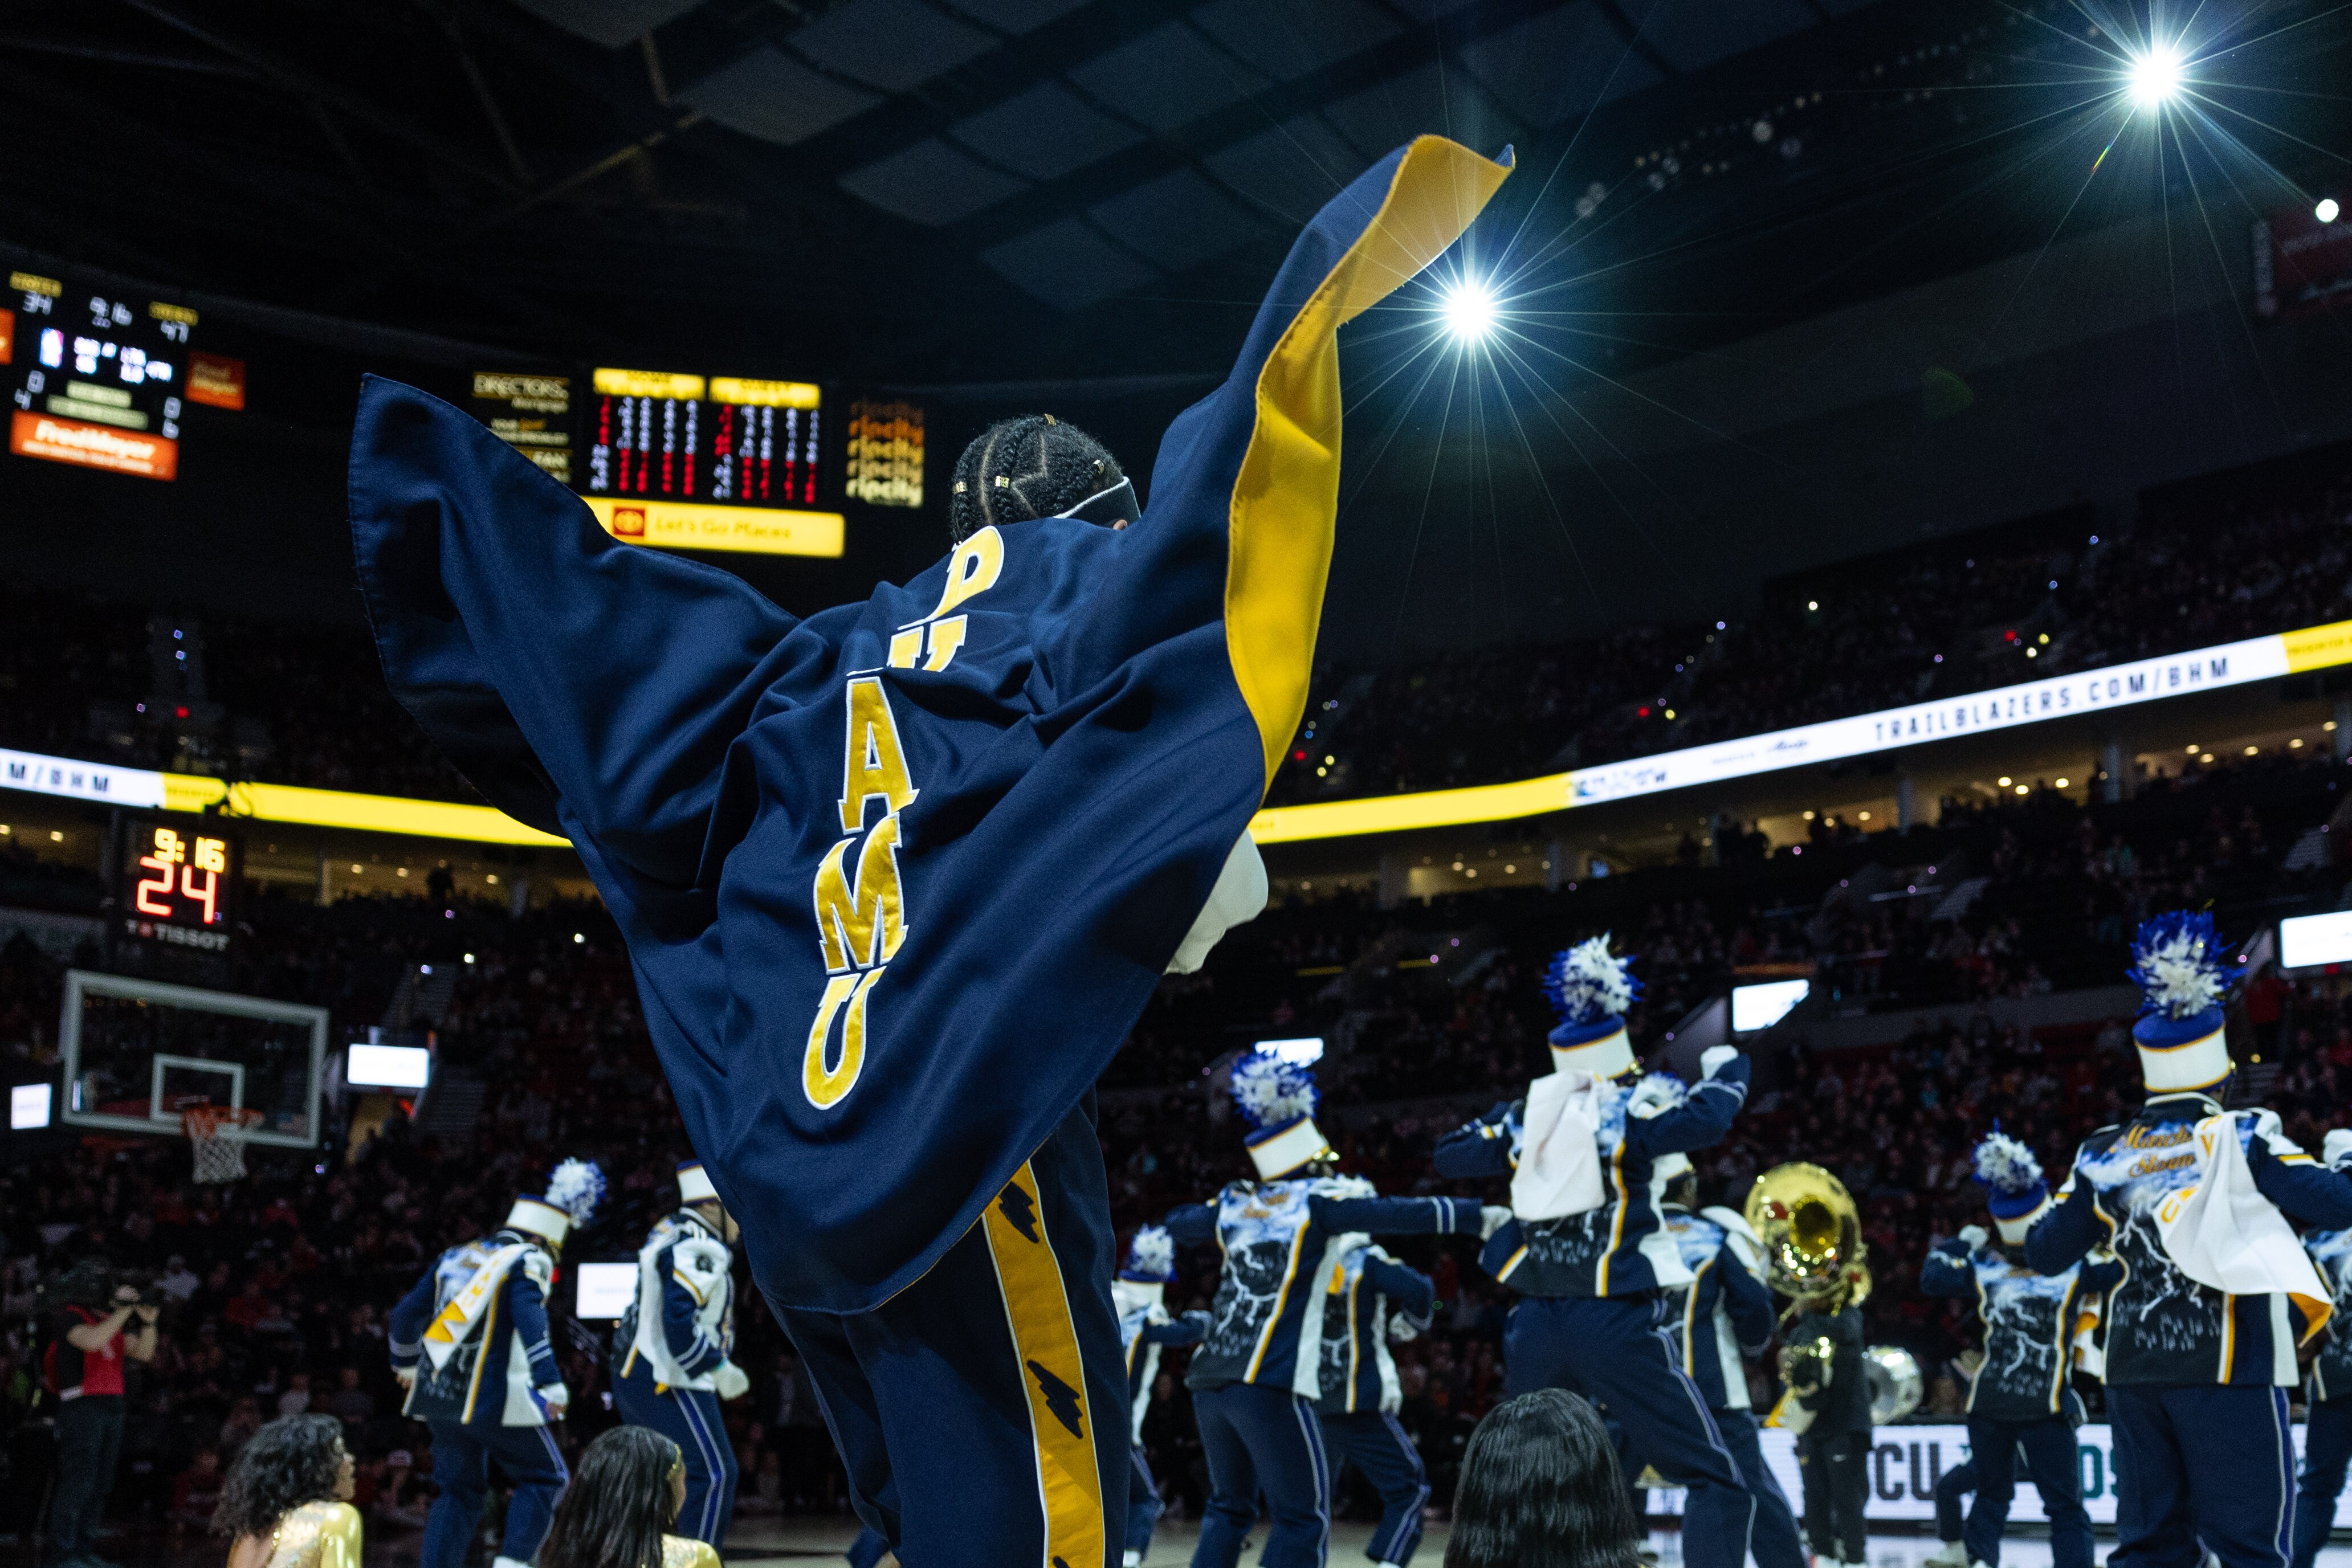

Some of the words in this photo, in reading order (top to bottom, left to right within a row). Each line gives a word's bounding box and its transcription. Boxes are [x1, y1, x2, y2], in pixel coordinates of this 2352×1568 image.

[22, 291, 52, 315] 34
[160, 320, 189, 343] 47
[702, 518, 728, 536] Go
[734, 522, 791, 539] Places
[1875, 657, 2228, 741] TRAILBLAZERS.COM/BHM
[154, 828, 225, 873] 9:16
[137, 856, 217, 924] 24
[154, 922, 230, 952] TISSOT
